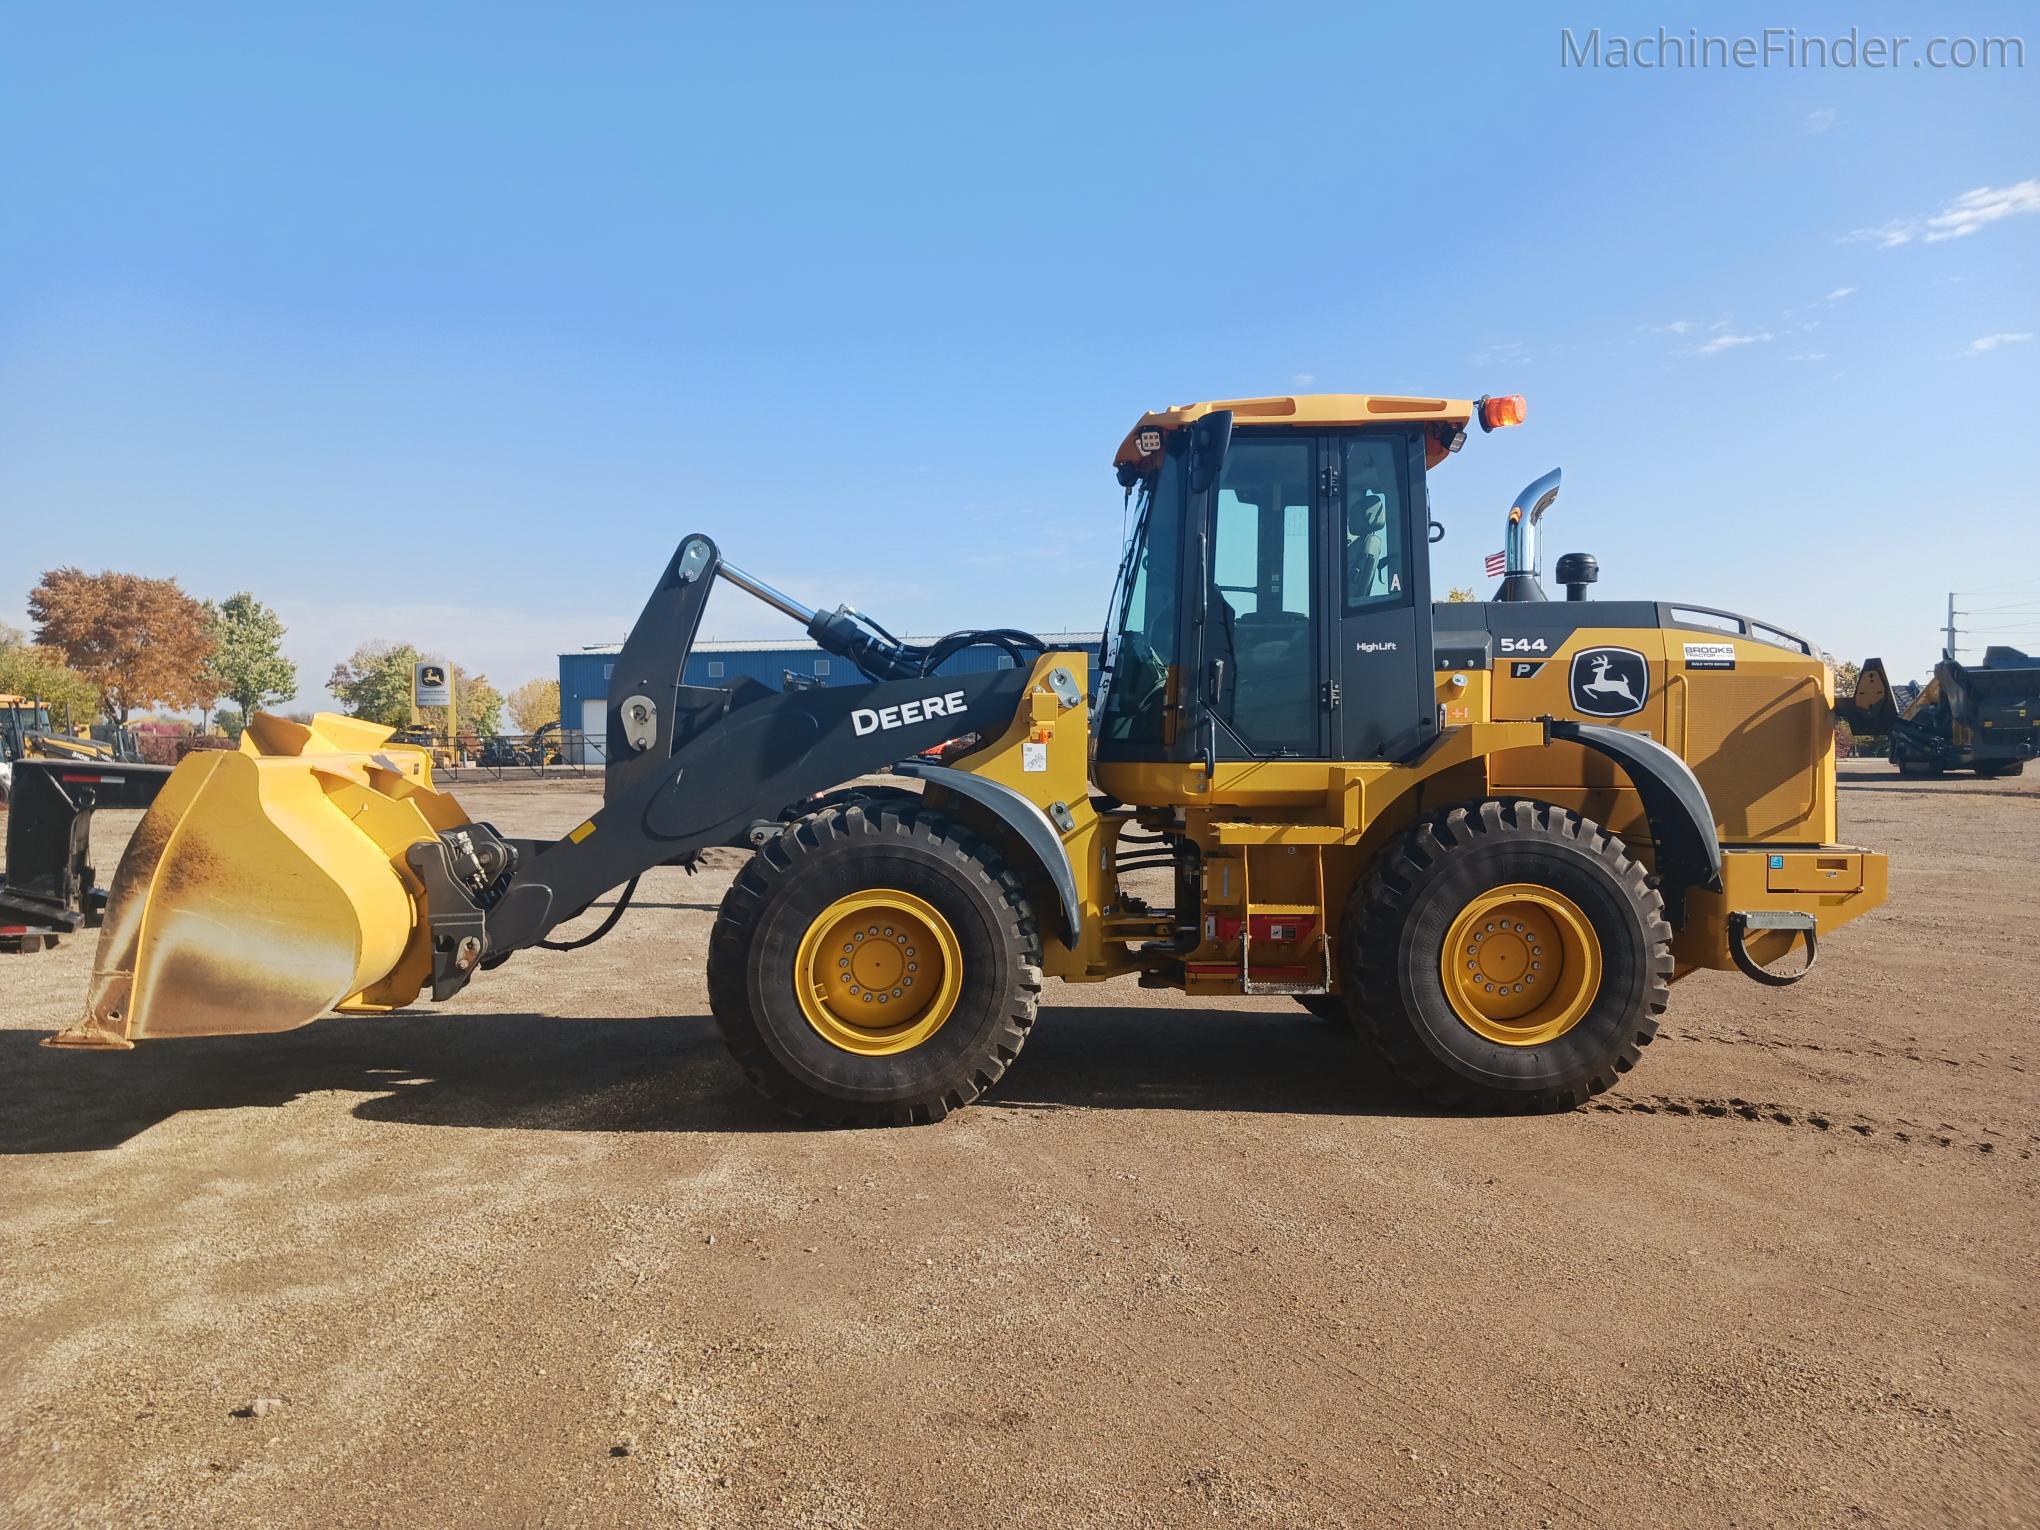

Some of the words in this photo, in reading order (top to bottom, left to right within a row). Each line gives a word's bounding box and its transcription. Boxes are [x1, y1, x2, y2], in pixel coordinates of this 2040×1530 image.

[1390, 573, 1402, 592] A
[1500, 637, 1548, 652] 544
[1516, 663, 1531, 677] P
[851, 690, 968, 736] DEERE
